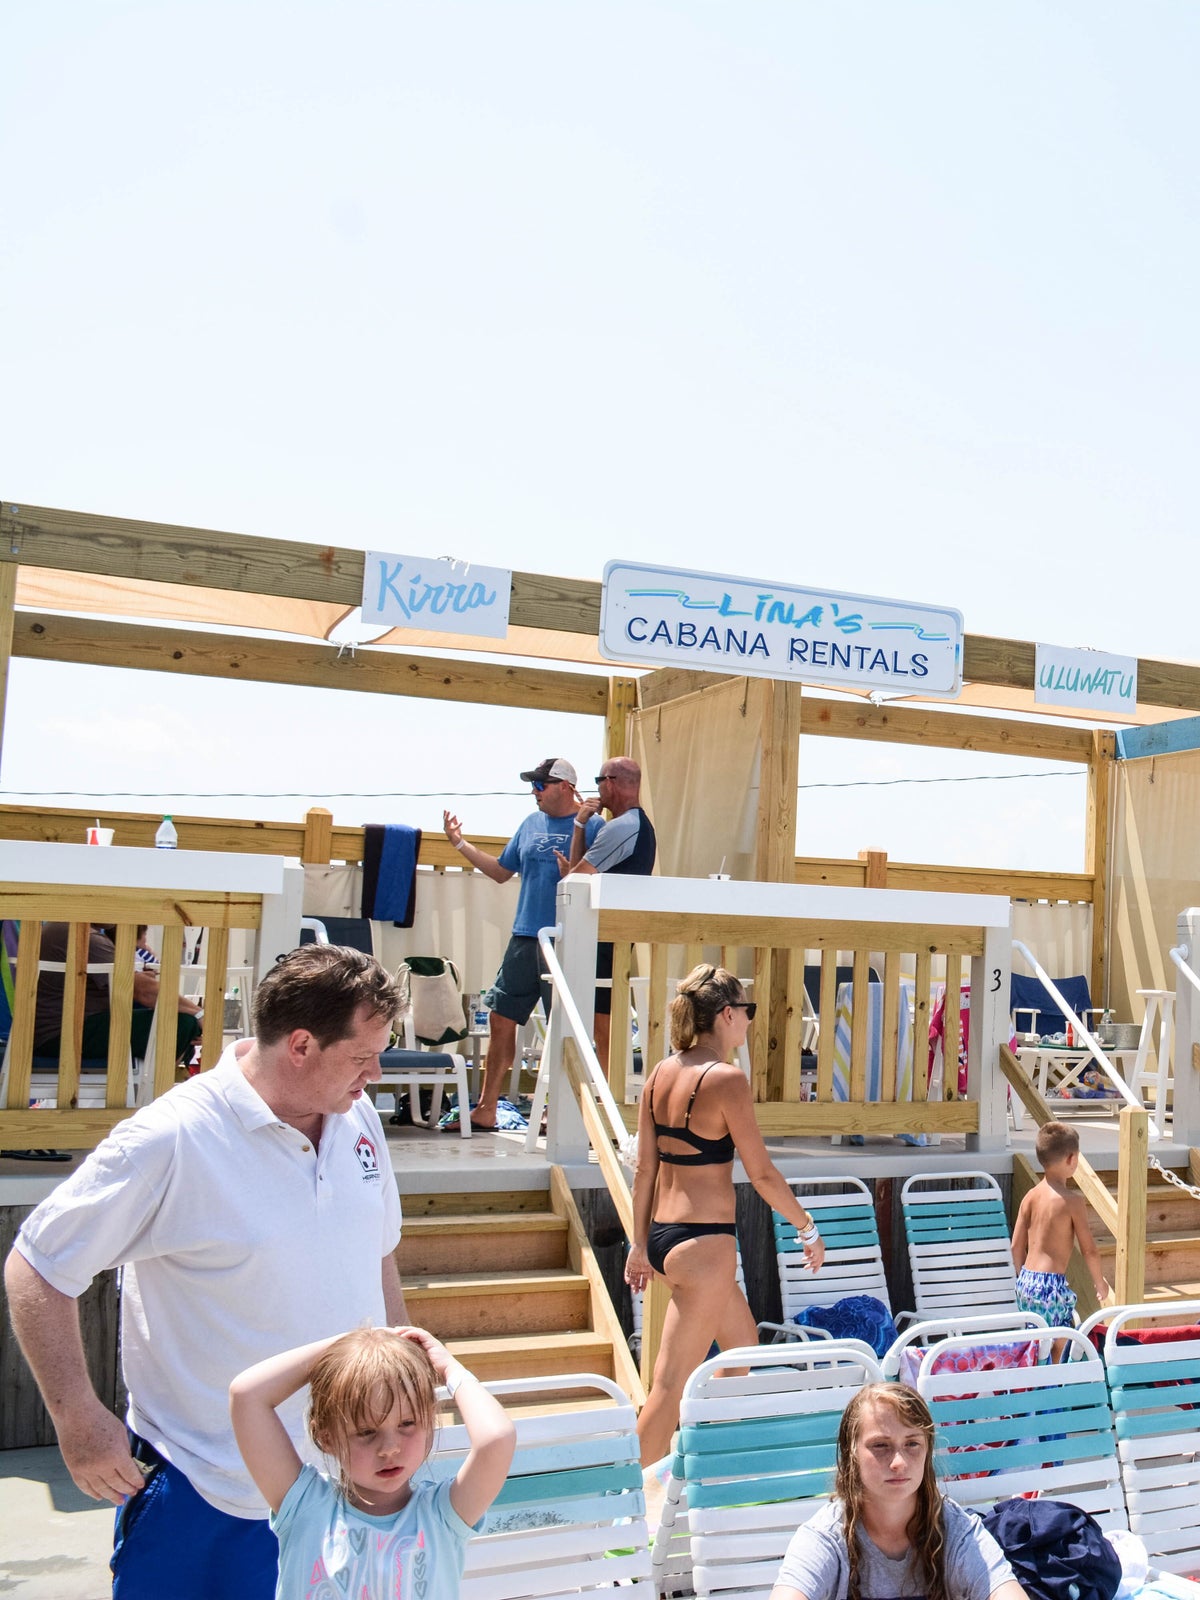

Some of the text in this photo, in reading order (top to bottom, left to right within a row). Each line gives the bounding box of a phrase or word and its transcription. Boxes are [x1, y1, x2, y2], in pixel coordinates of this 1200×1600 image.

[377, 560, 496, 620] Kirra
[627, 616, 929, 677] CABANA RENTALS
[1039, 664, 1134, 698] ULUWATU
[990, 968, 1002, 992] 3
